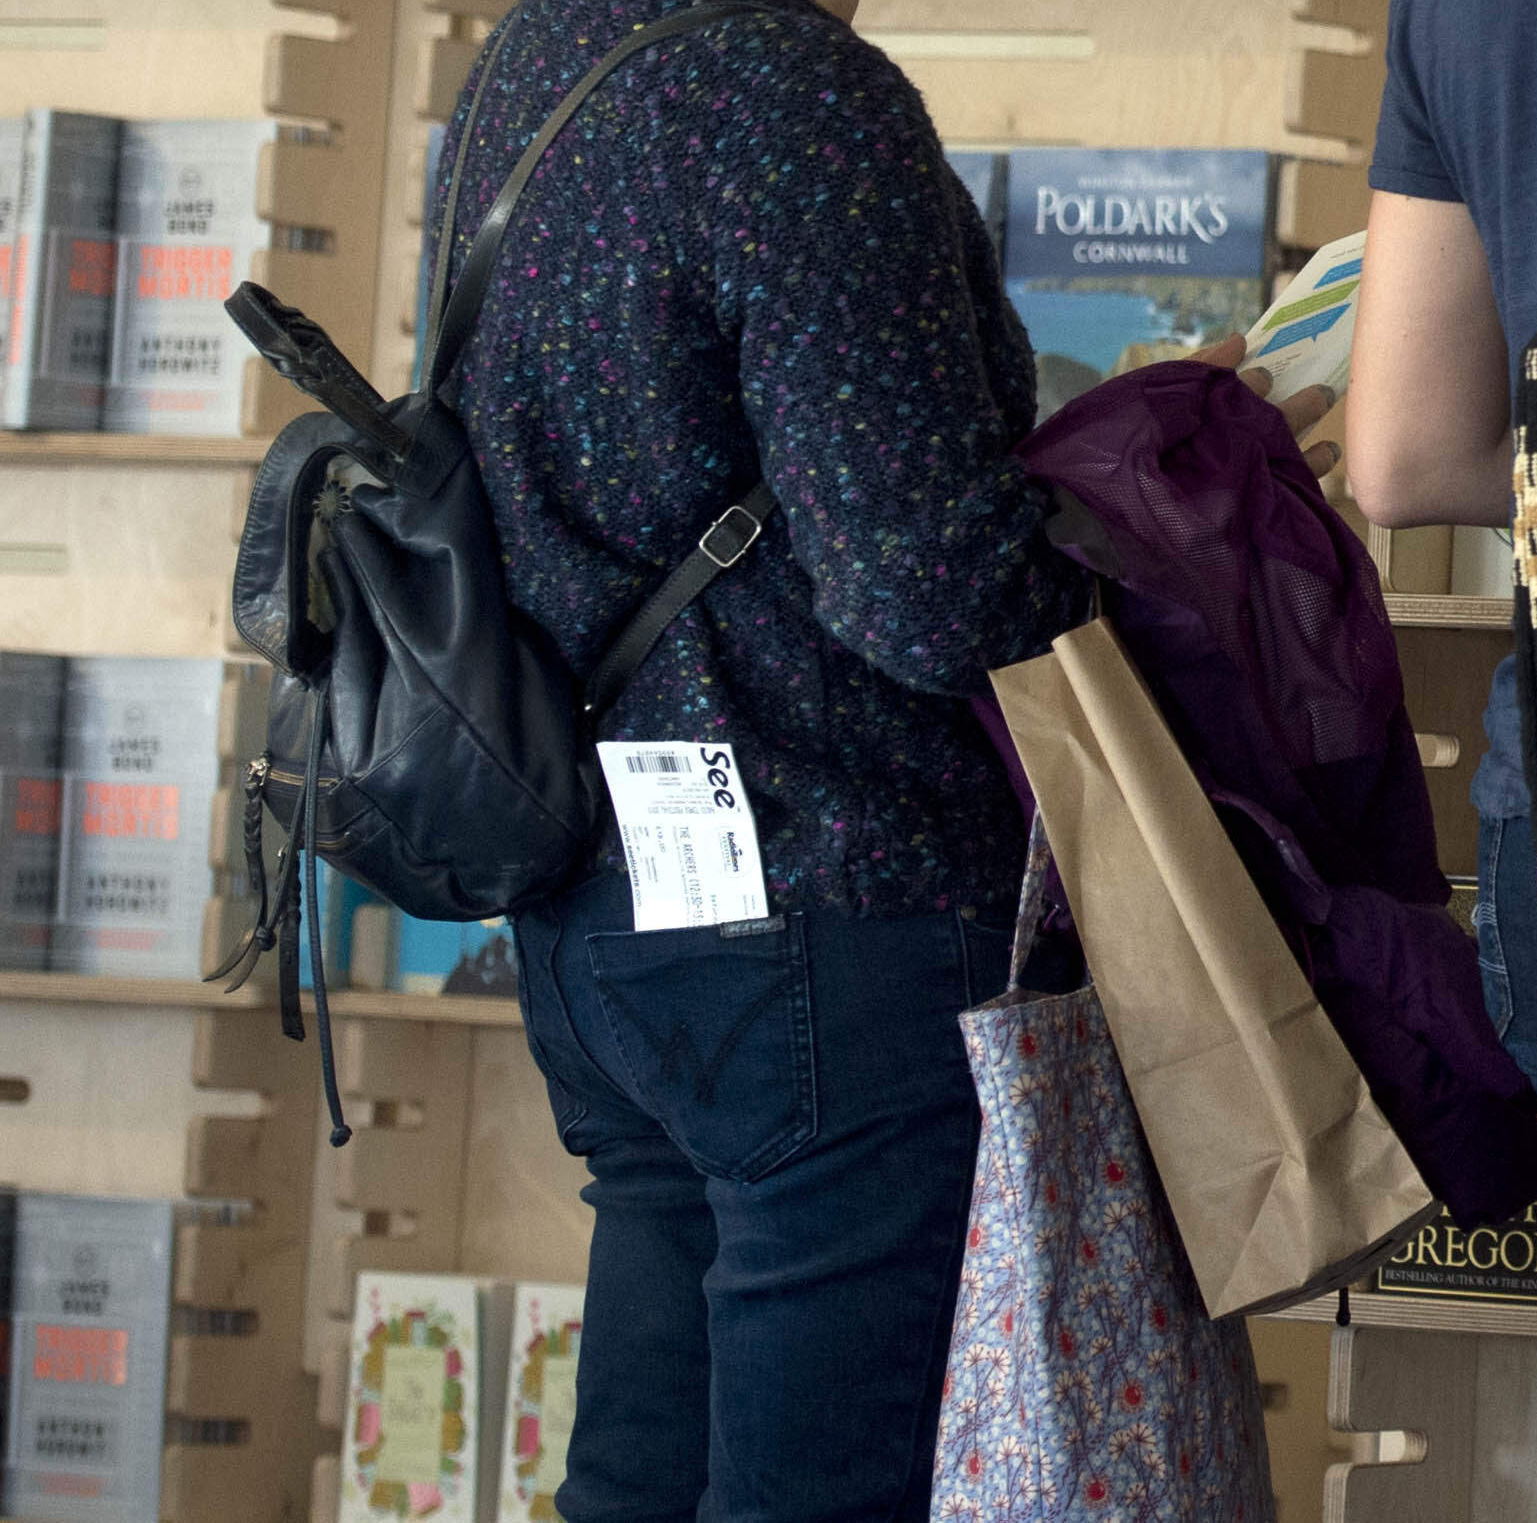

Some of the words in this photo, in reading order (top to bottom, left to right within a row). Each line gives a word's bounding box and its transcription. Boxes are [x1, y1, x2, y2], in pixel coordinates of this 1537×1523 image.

[1035, 185, 1230, 245] POLDARK'S
[1072, 241, 1191, 266] CORNWALL
[699, 746, 736, 809] See
